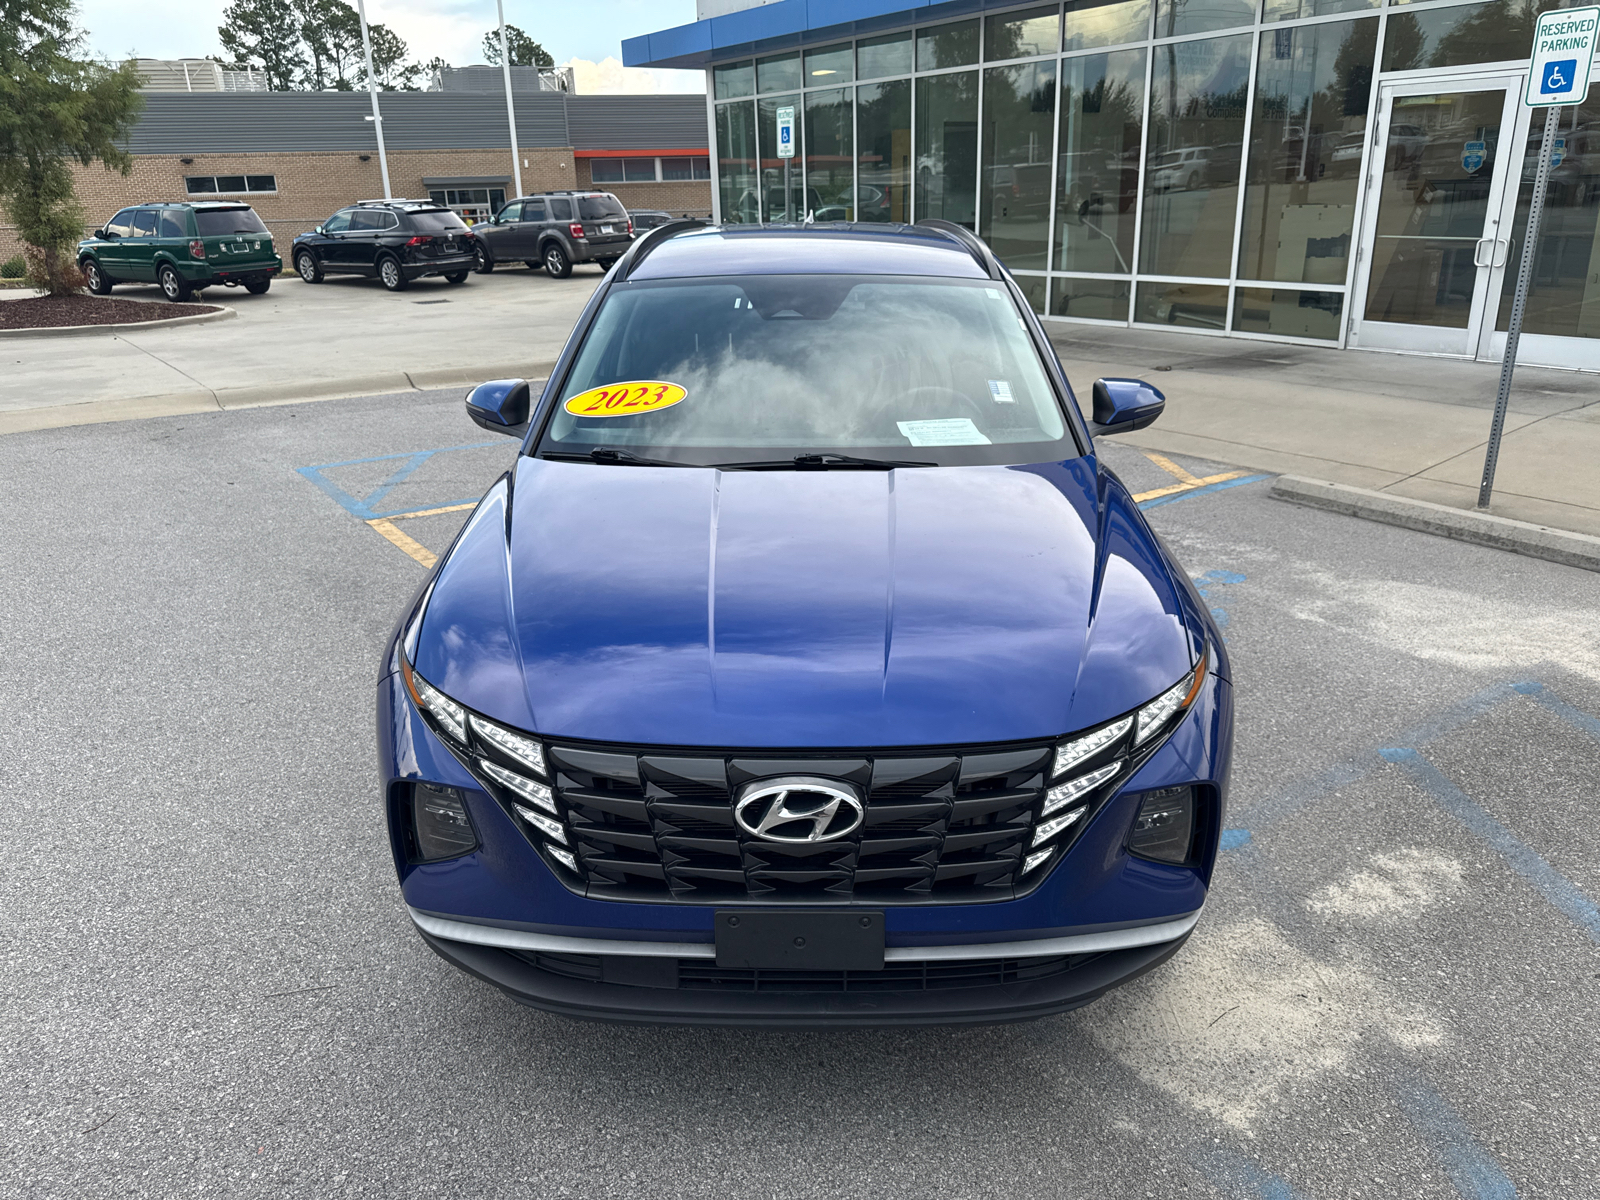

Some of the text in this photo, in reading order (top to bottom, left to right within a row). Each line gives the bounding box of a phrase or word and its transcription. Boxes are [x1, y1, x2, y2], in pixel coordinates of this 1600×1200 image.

[1541, 19, 1594, 36] RESERVED
[1540, 36, 1588, 52] PARKING
[1206, 105, 1244, 120] Complete
[583, 385, 669, 412] 2023
